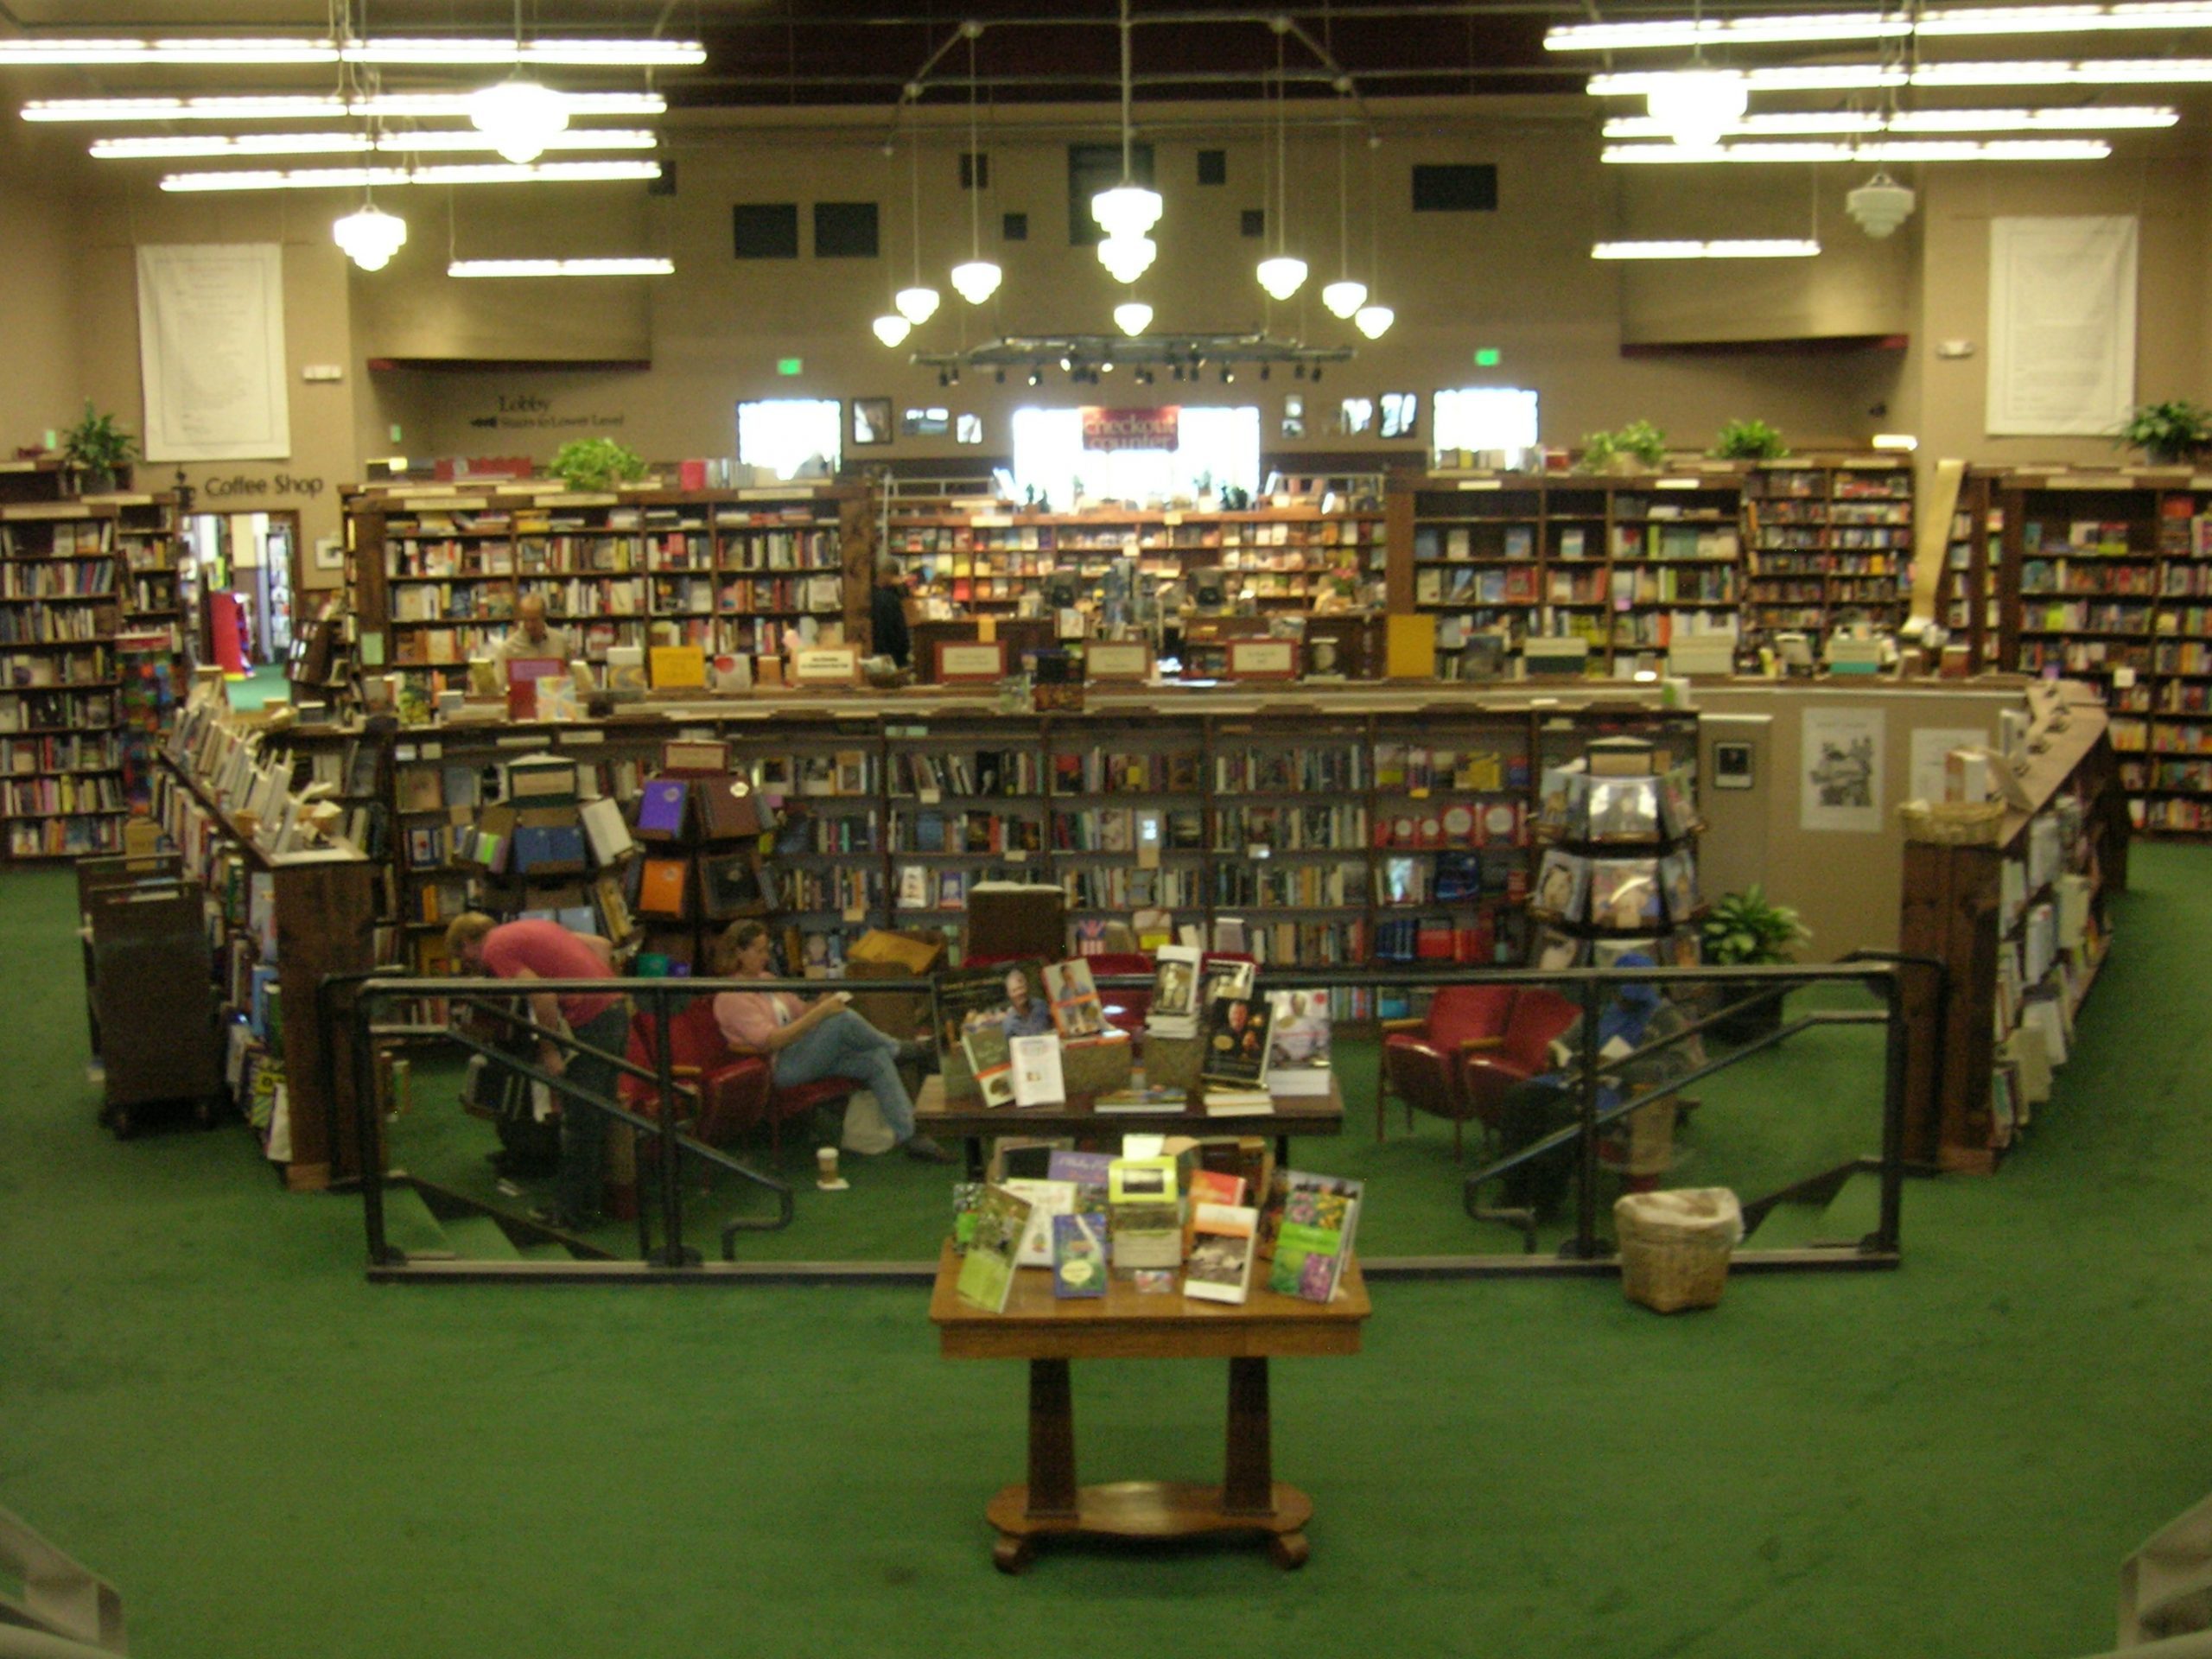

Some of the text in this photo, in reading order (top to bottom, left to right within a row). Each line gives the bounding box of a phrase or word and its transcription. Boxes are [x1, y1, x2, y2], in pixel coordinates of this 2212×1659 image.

[499, 395, 550, 412] Lobby
[1084, 414, 1177, 434] checkout
[1087, 435, 1172, 449] counter
[205, 474, 323, 499] Coffee Shop
